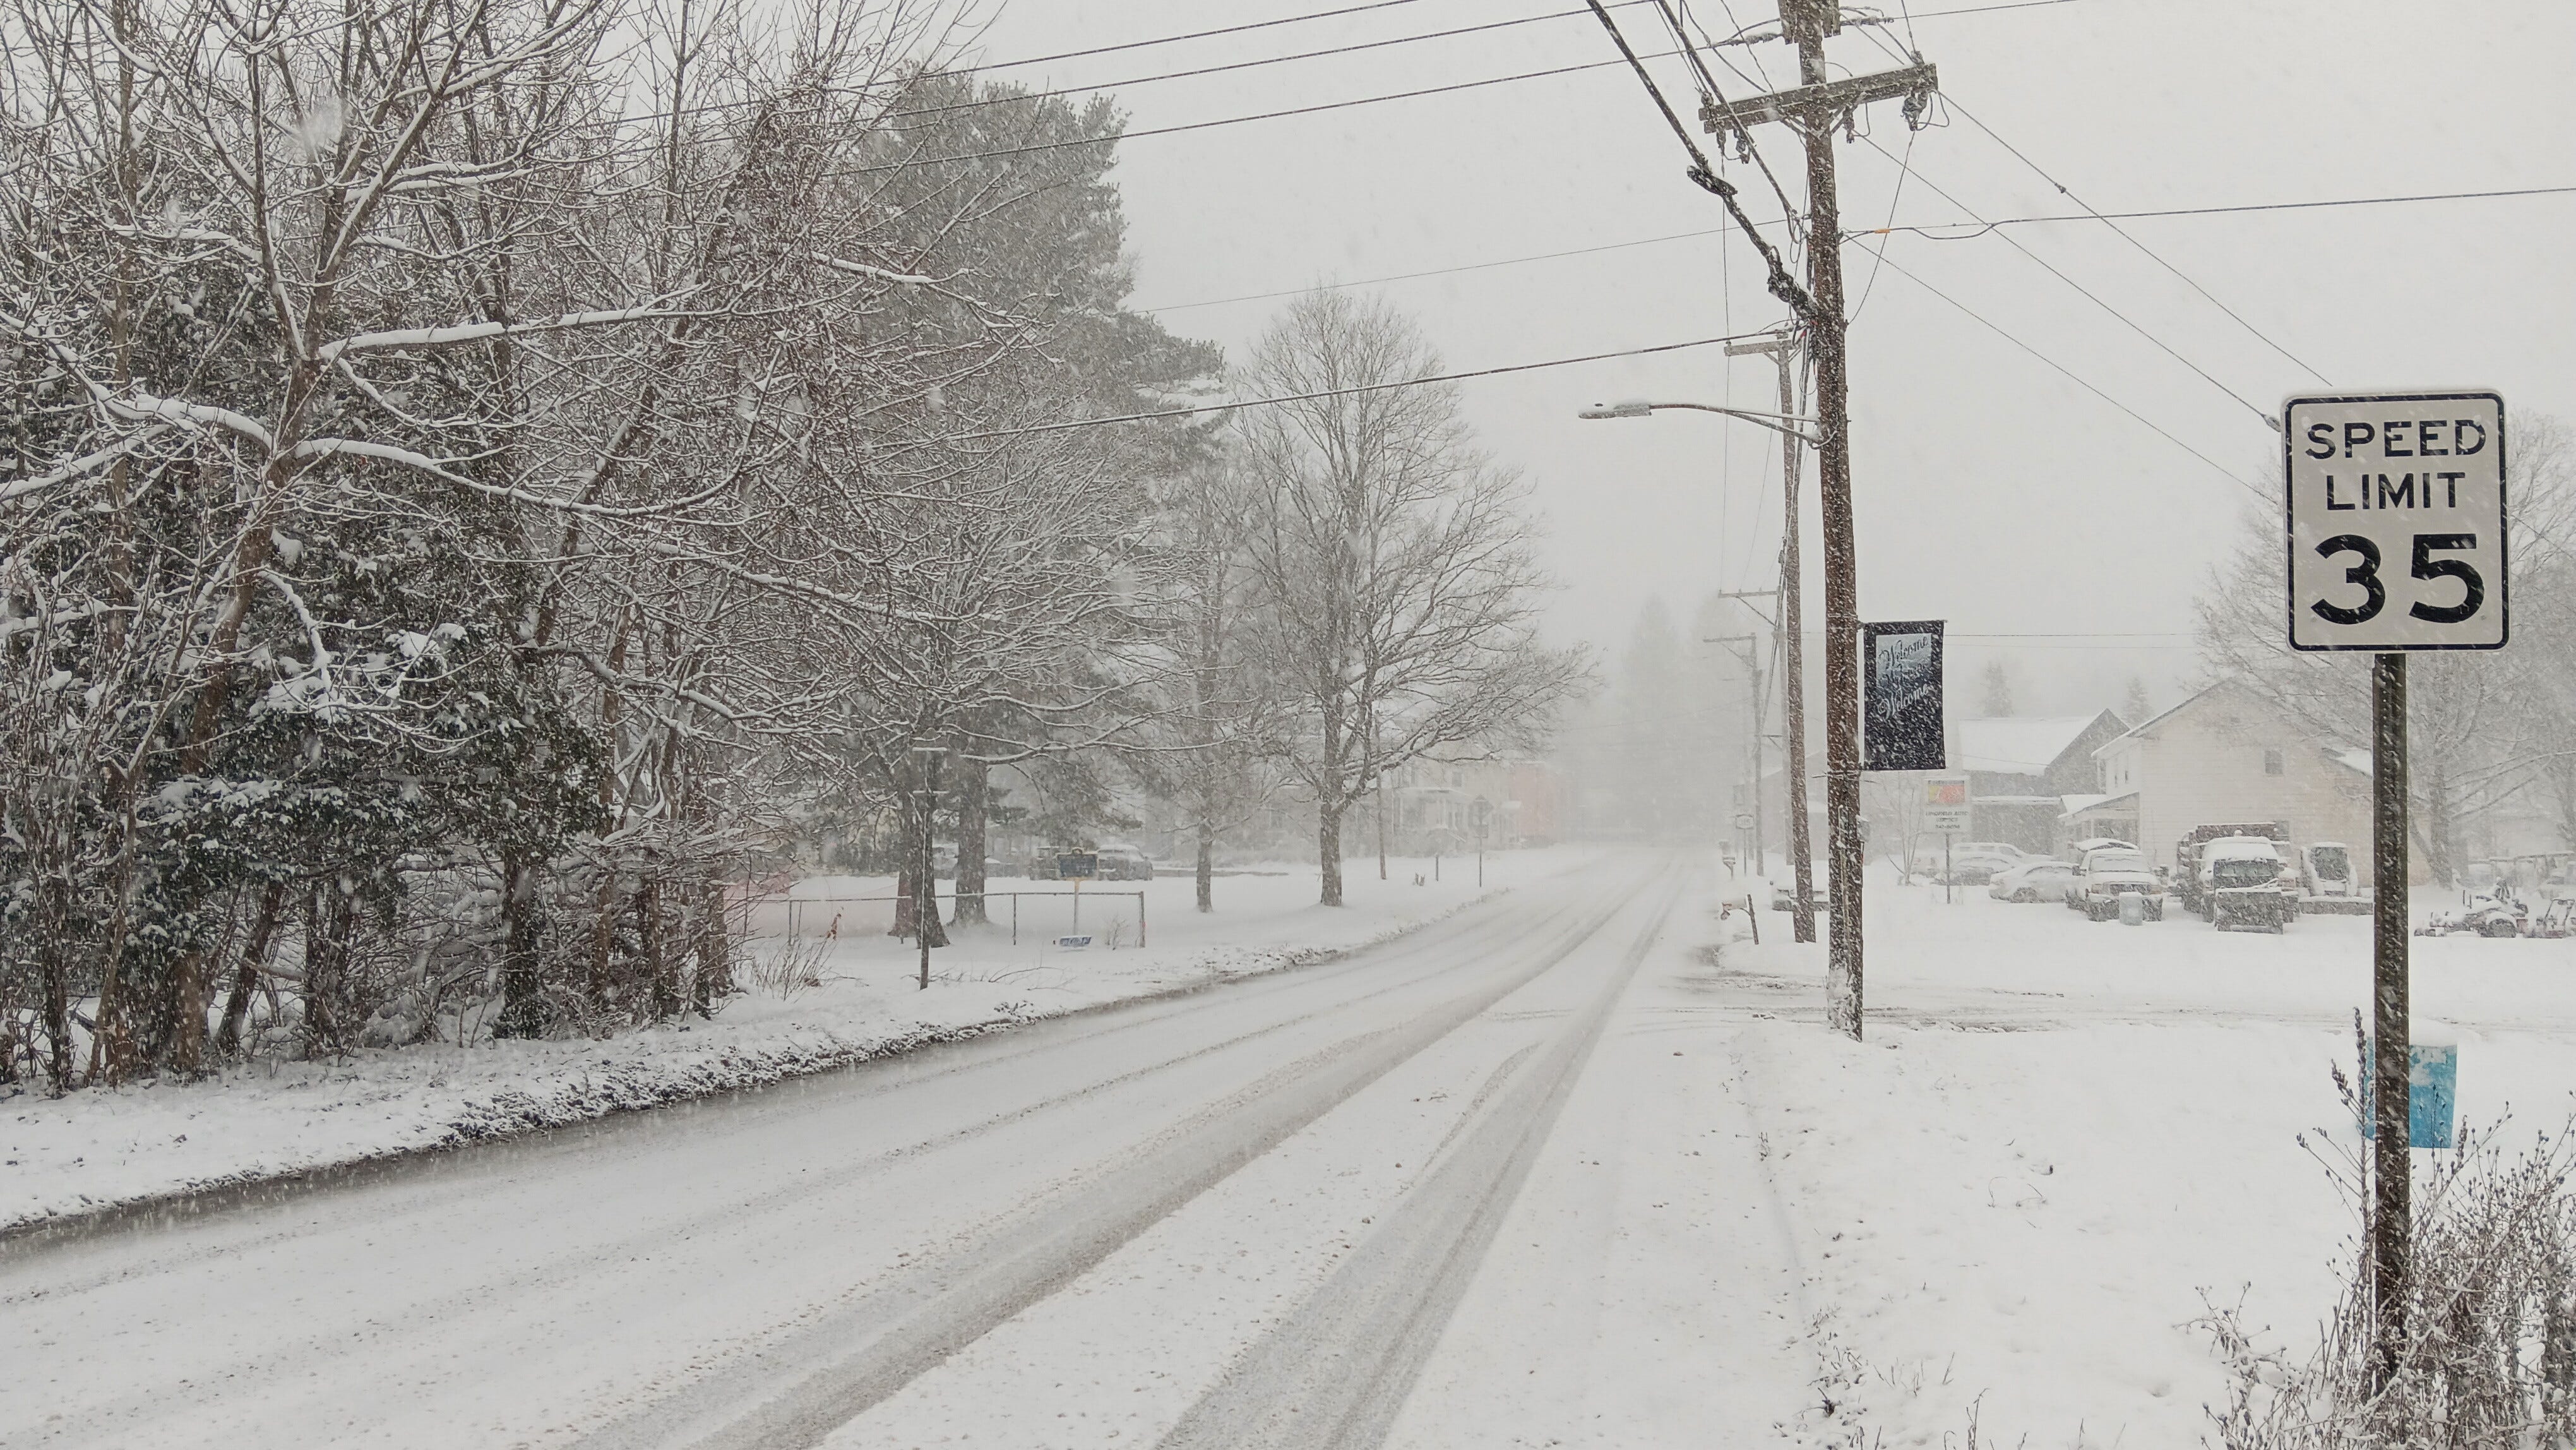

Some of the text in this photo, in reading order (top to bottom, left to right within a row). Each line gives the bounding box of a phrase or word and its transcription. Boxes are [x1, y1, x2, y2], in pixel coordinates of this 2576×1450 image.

[2305, 419, 2486, 460] SPEED
[2326, 472, 2466, 510] LIMIT
[2310, 534, 2485, 625] 35
[1877, 636, 1929, 670] Welcome
[1876, 683, 1929, 721] Welcome
